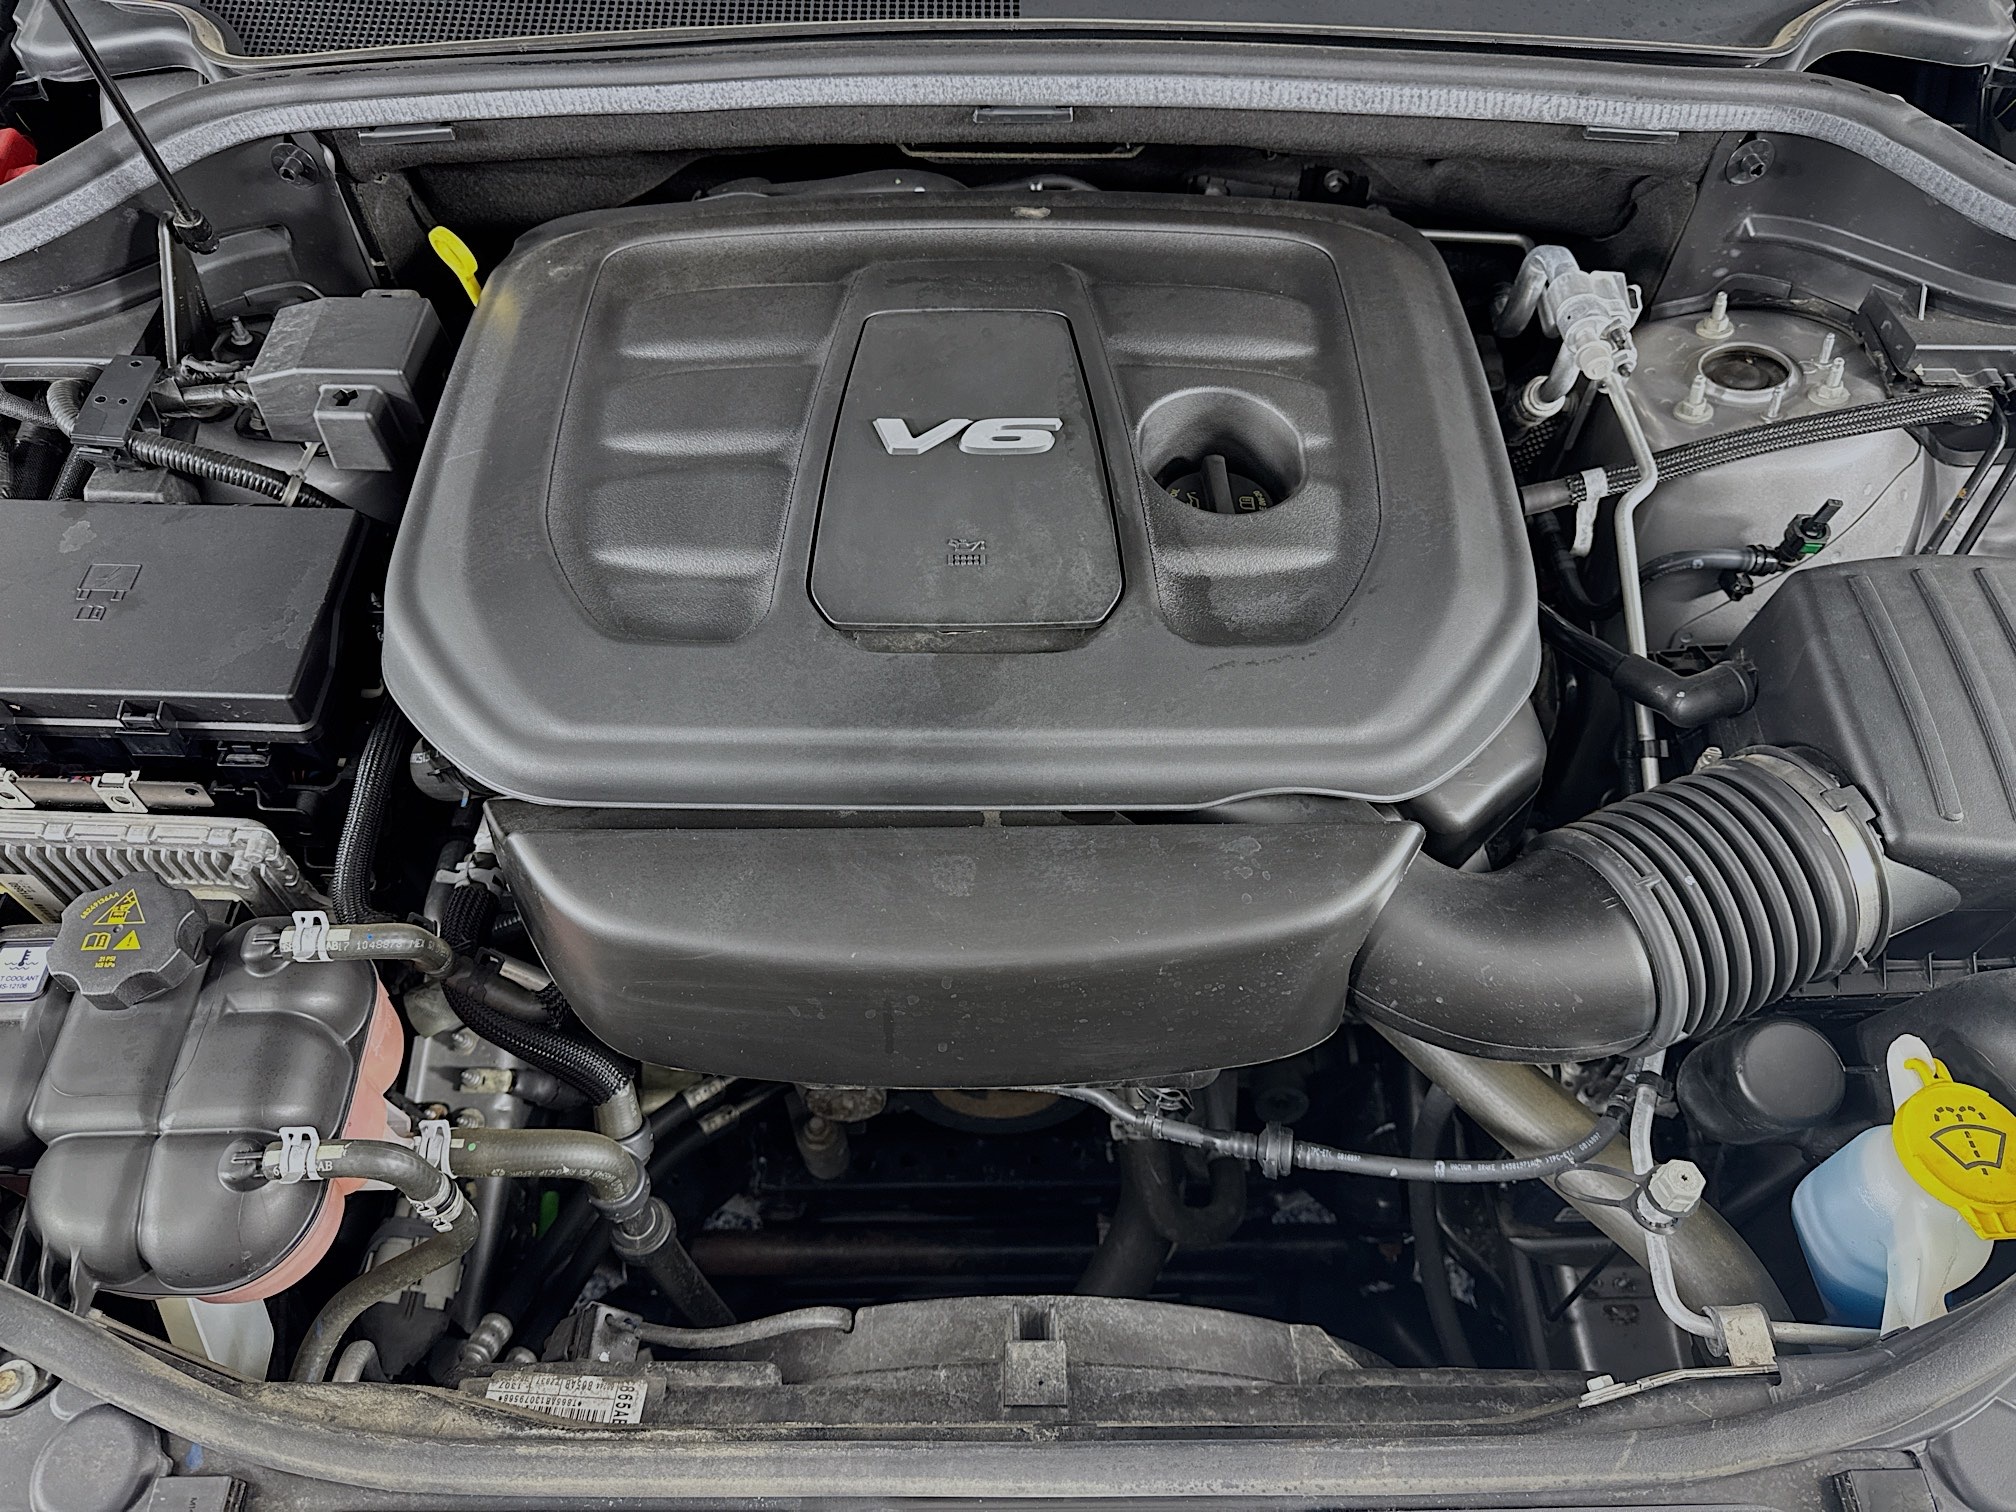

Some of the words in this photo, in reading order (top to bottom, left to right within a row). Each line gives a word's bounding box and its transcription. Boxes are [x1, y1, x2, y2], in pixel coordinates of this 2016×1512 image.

[872, 417, 1063, 455] V6
[1450, 1163, 1471, 1171] VACUUM
[1477, 1163, 1496, 1171] BRAKE
